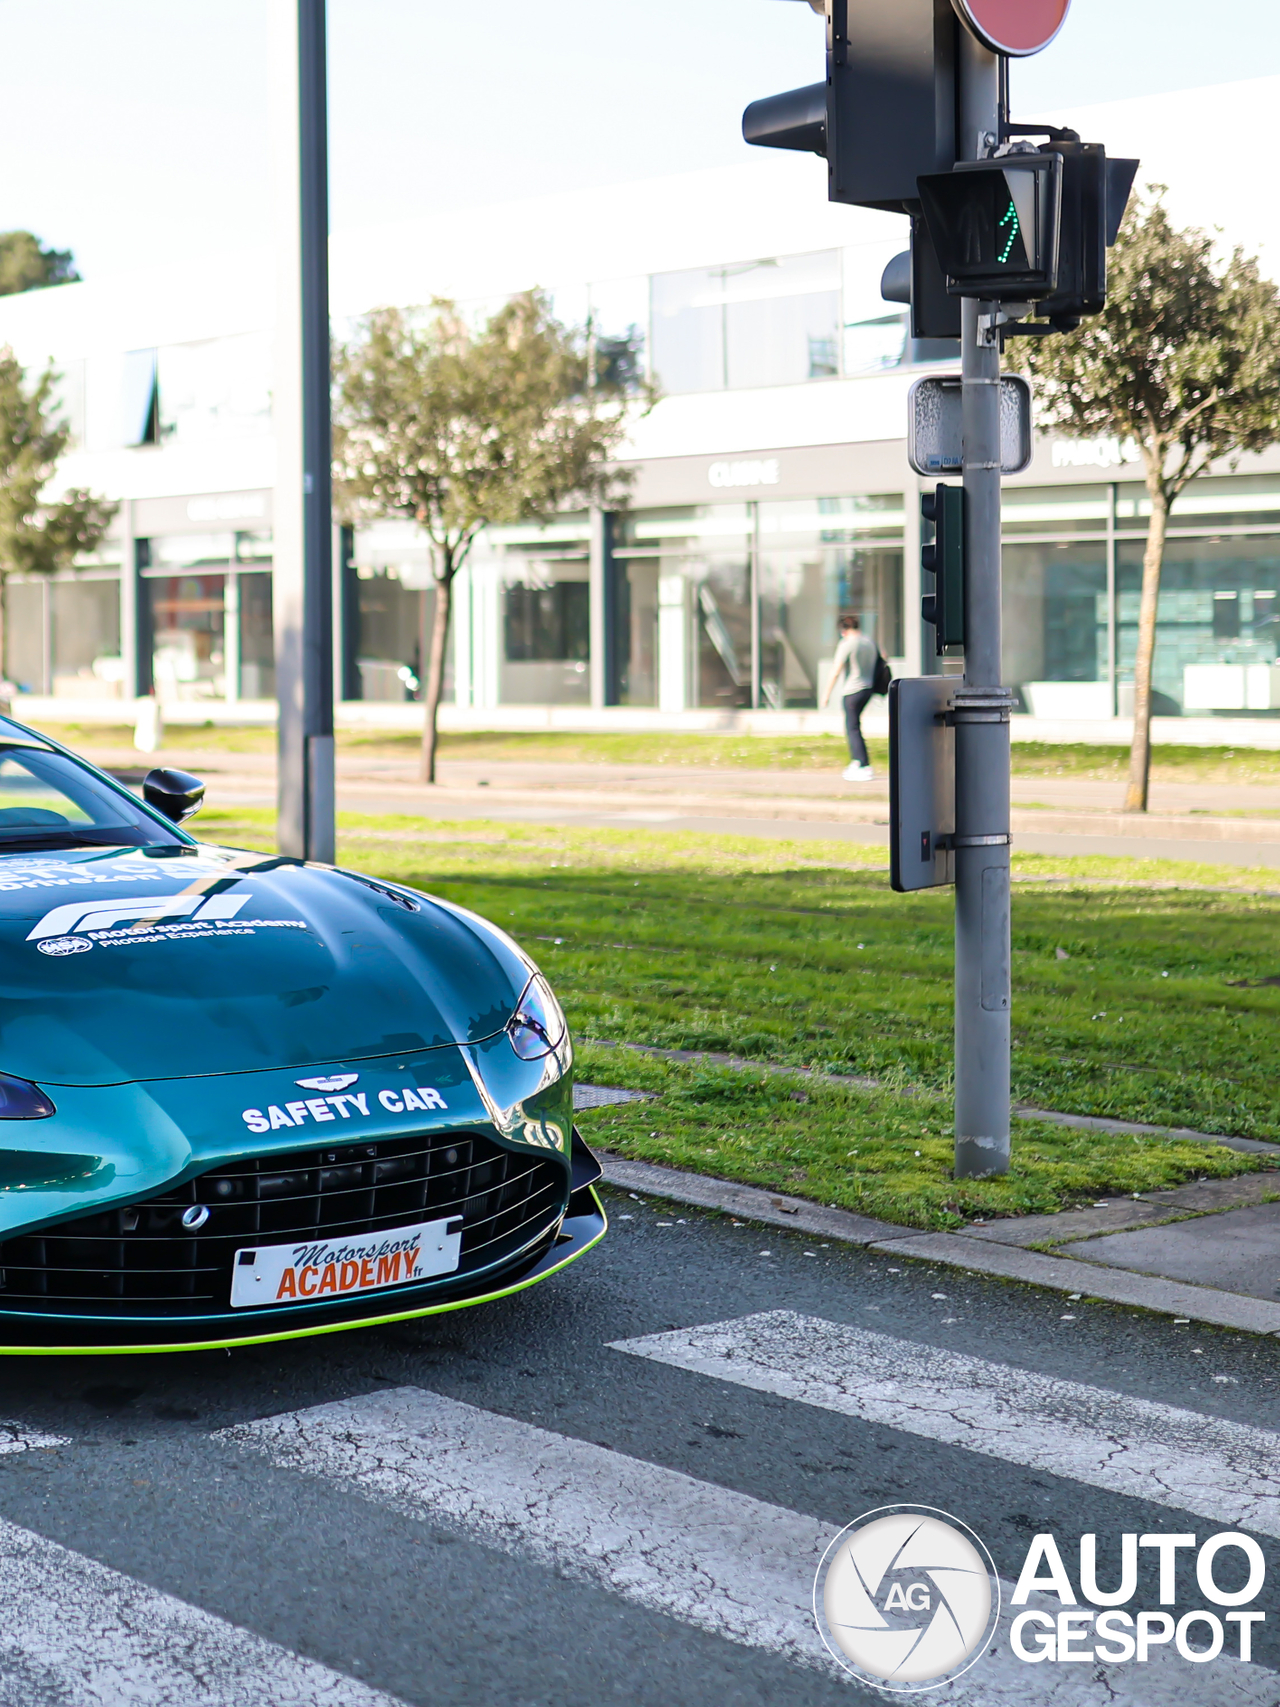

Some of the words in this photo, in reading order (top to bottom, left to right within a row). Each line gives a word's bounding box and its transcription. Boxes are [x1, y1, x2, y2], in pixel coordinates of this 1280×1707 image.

[88, 921, 213, 940] Motorsport
[214, 919, 307, 928] Academy
[99, 934, 167, 948] Pilotage
[166, 928, 256, 940] Experience
[242, 1092, 370, 1133] SAFETY
[378, 1087, 448, 1113] CAR
[292, 1233, 422, 1267] Motorsport
